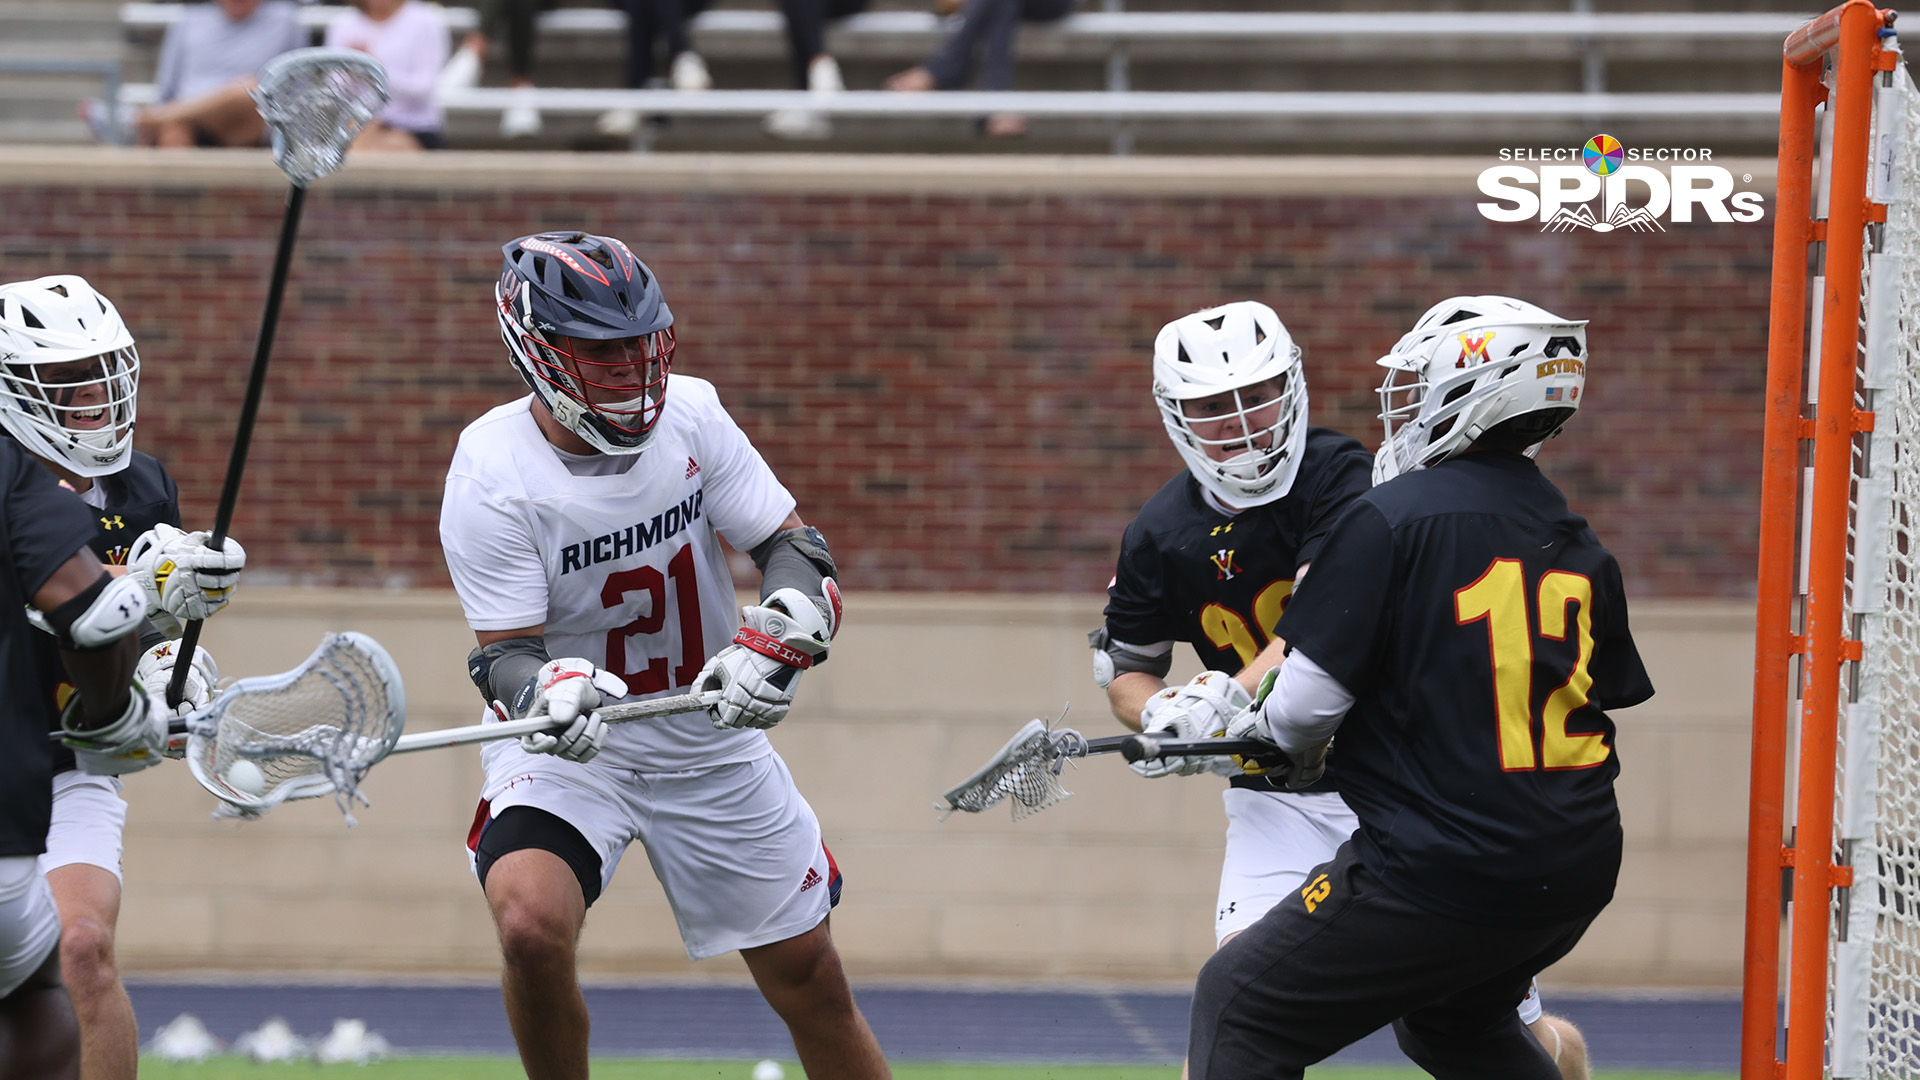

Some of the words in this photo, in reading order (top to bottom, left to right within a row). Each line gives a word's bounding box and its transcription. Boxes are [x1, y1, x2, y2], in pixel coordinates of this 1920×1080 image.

[600, 542, 706, 697] 21
[735, 631, 804, 664] AVERIK
[1453, 556, 1612, 773] 12
[1301, 873, 1332, 914] 12
